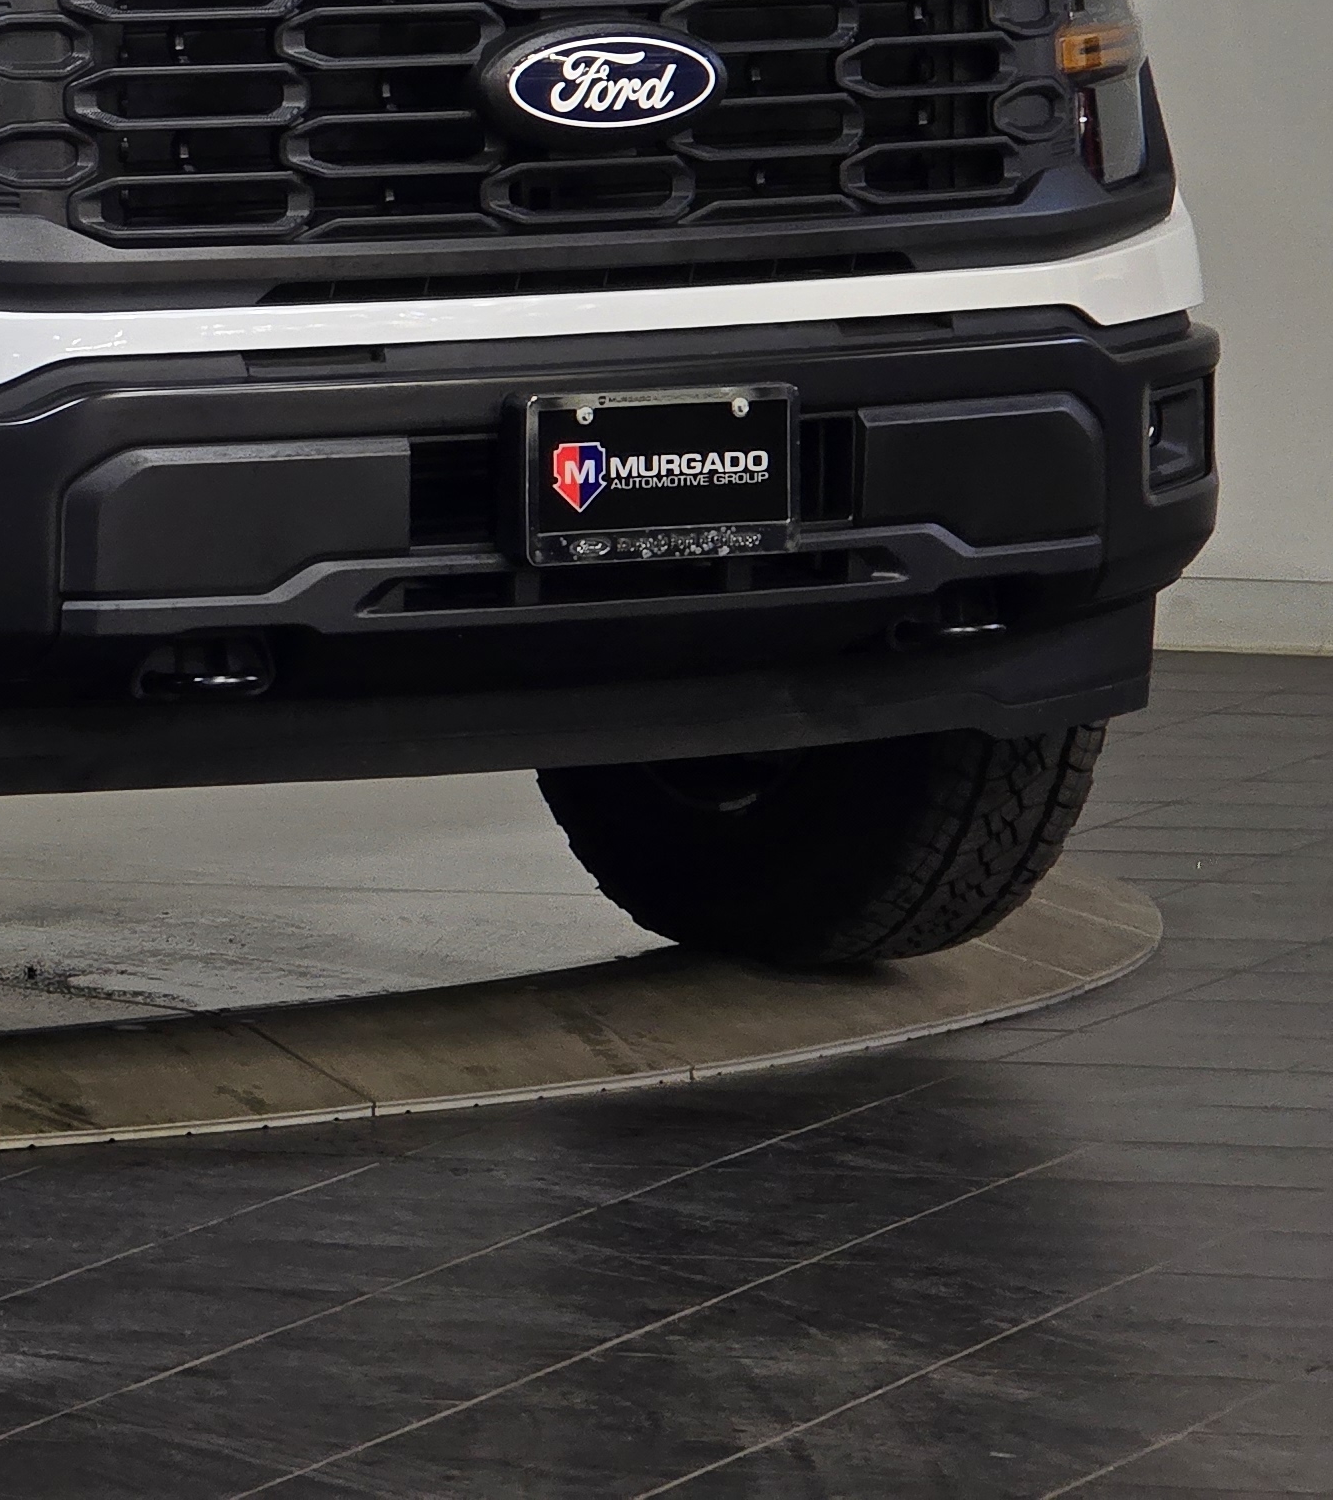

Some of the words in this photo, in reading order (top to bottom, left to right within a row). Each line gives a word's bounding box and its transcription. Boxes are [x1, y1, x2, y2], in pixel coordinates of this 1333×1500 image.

[550, 50, 677, 113] Ford
[564, 459, 596, 485] M
[609, 450, 769, 479] MURGADO
[610, 473, 710, 490] AUTOMOTIVE
[713, 471, 769, 485] GROUP
